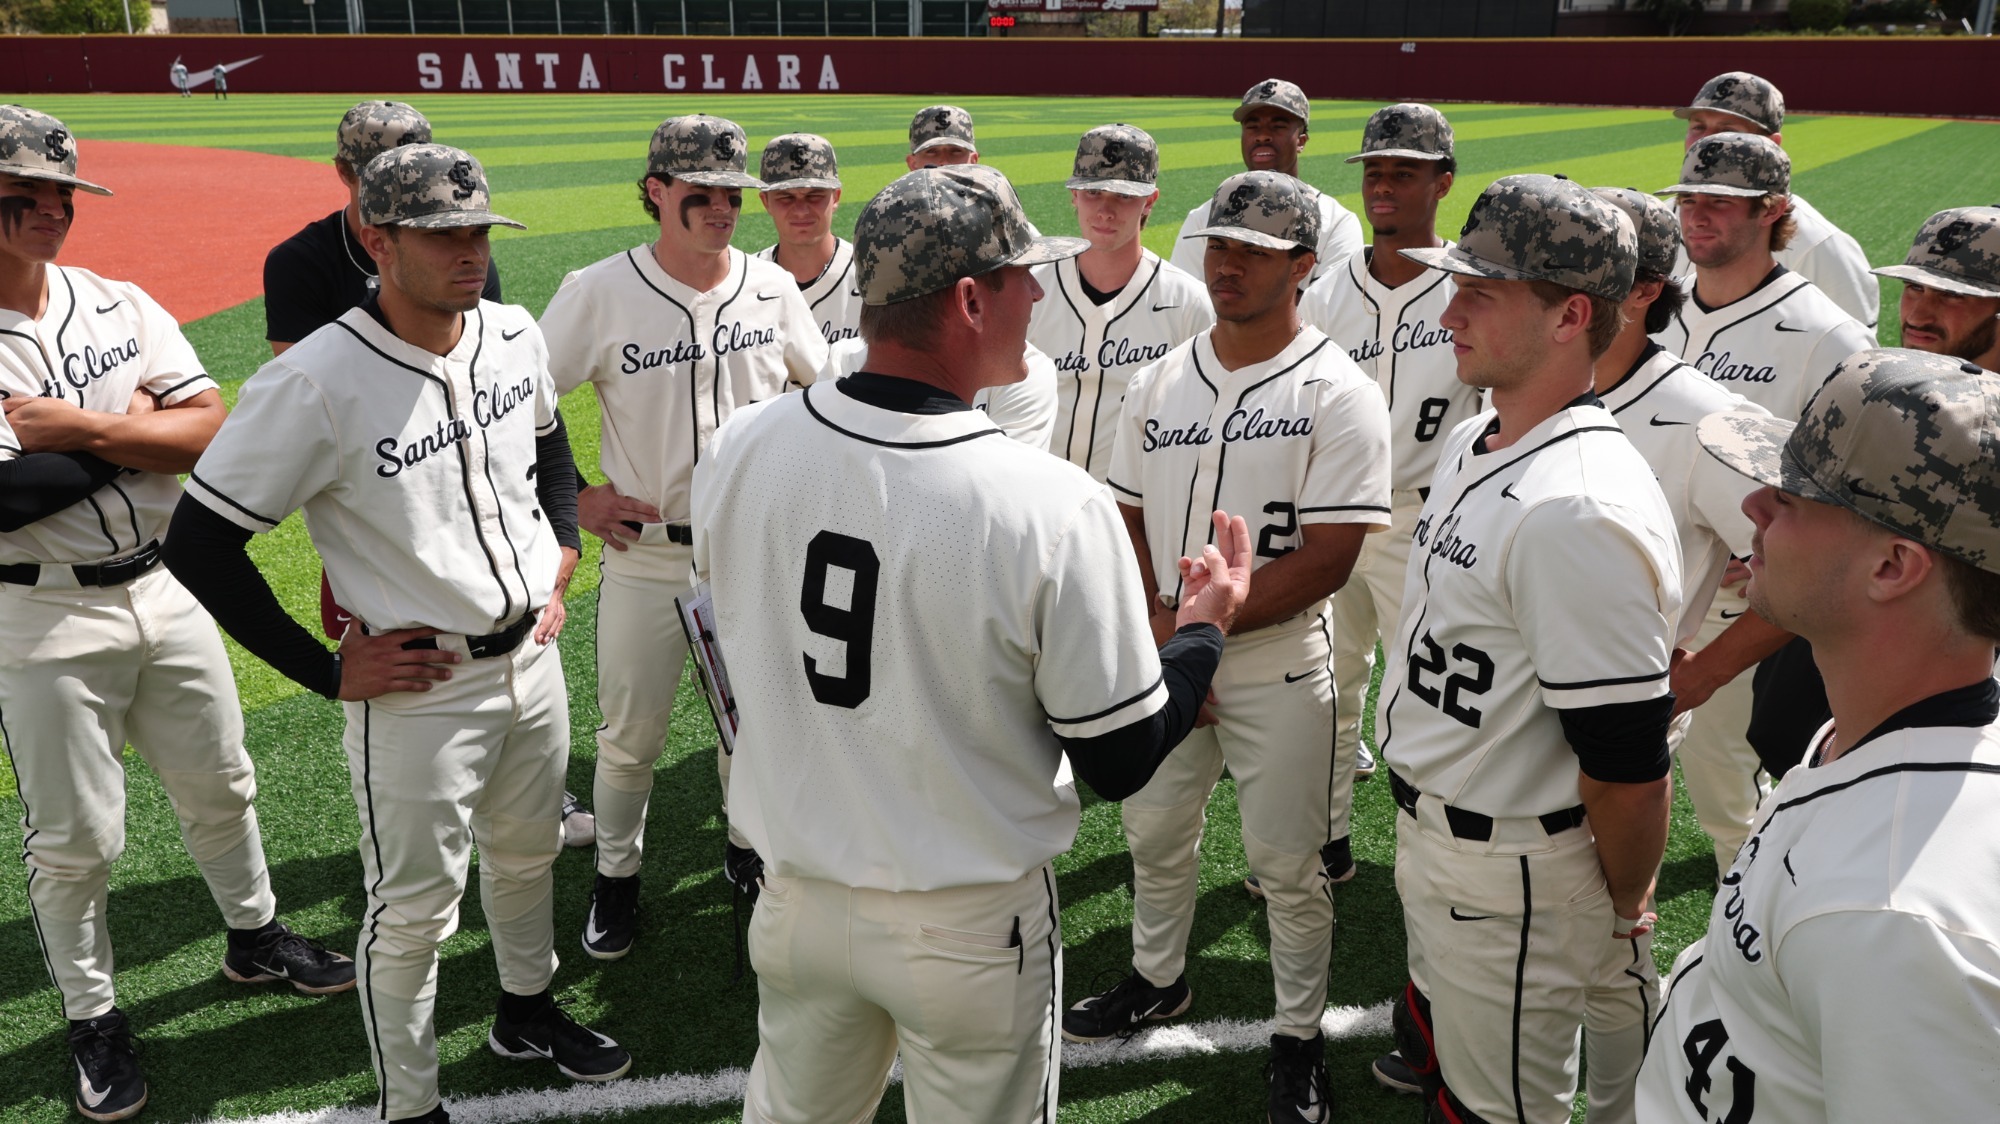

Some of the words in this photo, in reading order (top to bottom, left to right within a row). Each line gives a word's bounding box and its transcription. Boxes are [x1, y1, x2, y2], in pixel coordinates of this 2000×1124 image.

[990, 16, 1015, 27] 00:00
[417, 53, 600, 89] SANTA
[663, 53, 840, 90] CLARA
[621, 340, 706, 375] Santa
[712, 321, 775, 356] Clara
[822, 320, 860, 345] lar
[1054, 351, 1090, 372] nta
[1098, 337, 1173, 369] Clara
[1349, 339, 1385, 363] nta
[63, 337, 140, 389] Clara
[1694, 351, 1777, 383] Clara
[375, 420, 473, 478] Santa
[473, 376, 535, 429] Clara
[1143, 418, 1213, 453] Santa
[1222, 407, 1313, 443] Clara
[1415, 397, 1451, 443] 8
[1256, 500, 1297, 559] 2
[800, 529, 881, 710] 9
[1408, 627, 1496, 729] 22
